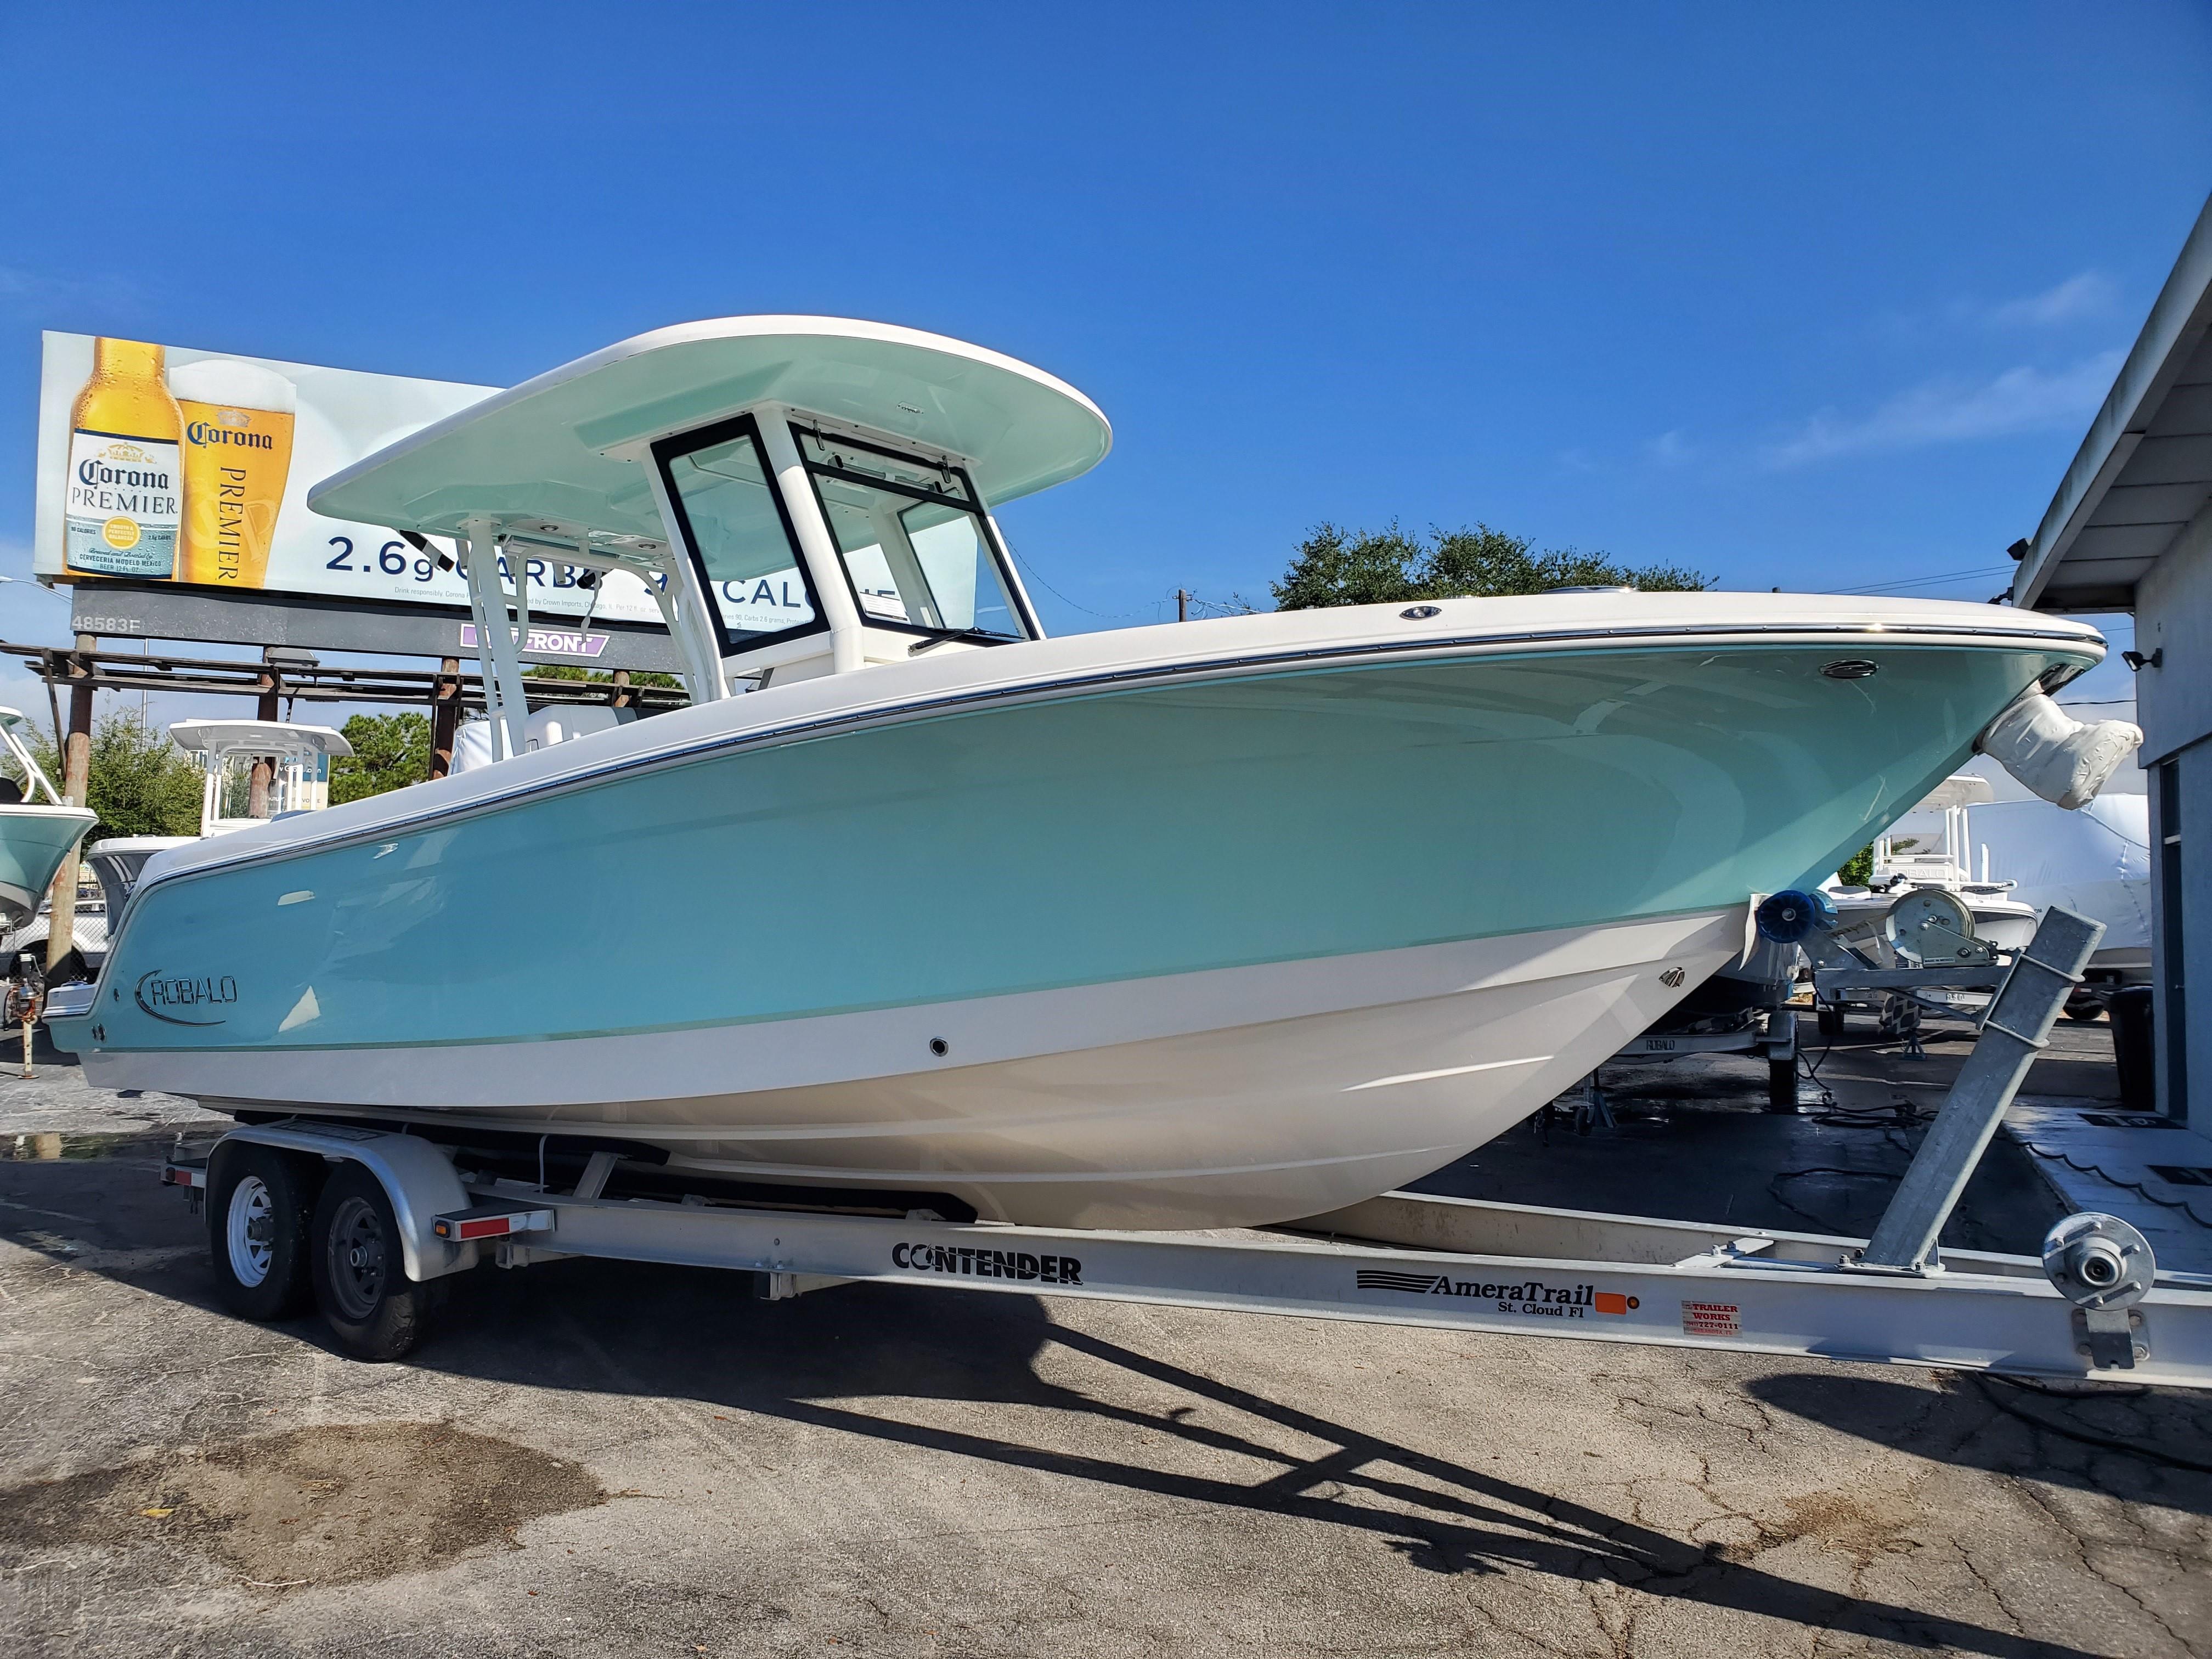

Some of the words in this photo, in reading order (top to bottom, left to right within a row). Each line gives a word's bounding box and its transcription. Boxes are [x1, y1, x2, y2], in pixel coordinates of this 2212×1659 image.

[187, 421, 273, 450] Corona
[79, 459, 169, 490] Corona
[72, 487, 177, 514] PREMIER
[218, 467, 247, 580] PREMIER
[80, 554, 114, 563] CERVECERIA
[115, 557, 140, 566] MODELO
[72, 616, 140, 633] 48583F
[150, 975, 238, 1006] ROBALO
[892, 1242, 1084, 1286] CONTENDER
[1431, 1276, 1594, 1306] AmeraTrail
[1498, 1301, 1517, 1313] St.
[1522, 1303, 1563, 1317] Cloud
[1692, 1304, 1738, 1312] TRAILER
[1693, 1312, 1730, 1321] WORKS
